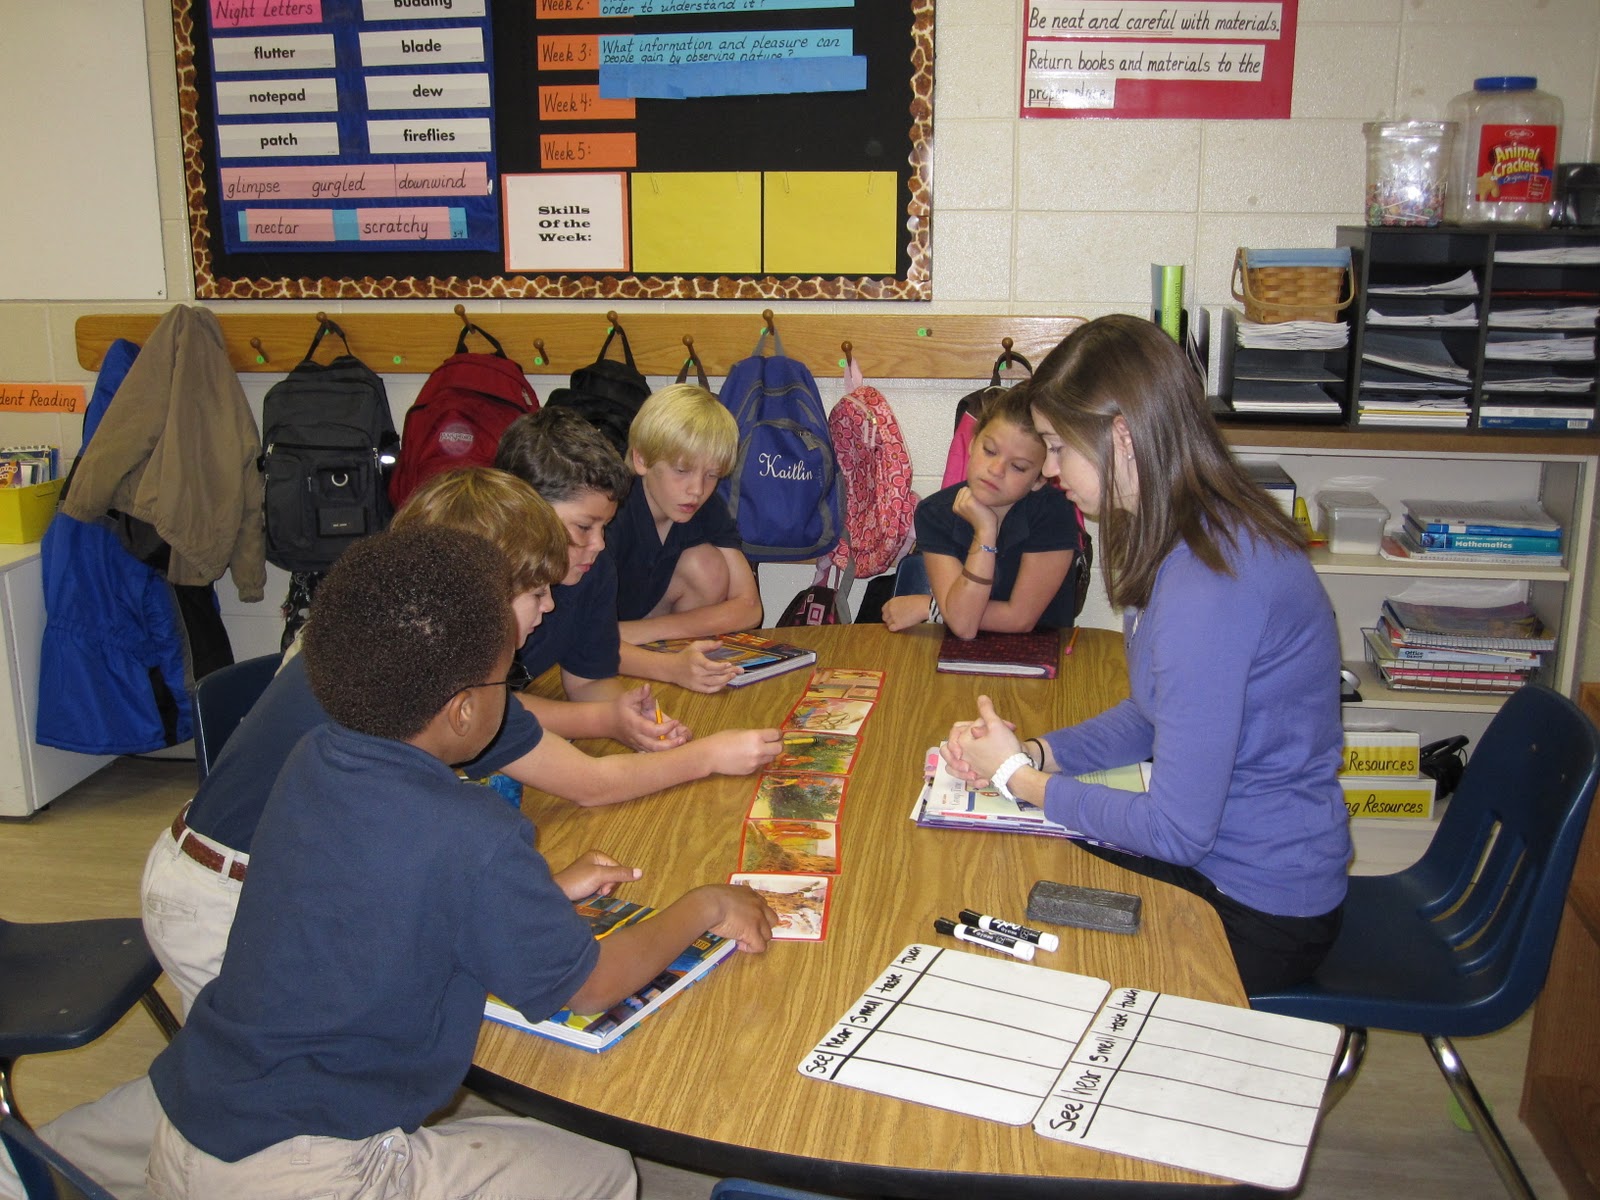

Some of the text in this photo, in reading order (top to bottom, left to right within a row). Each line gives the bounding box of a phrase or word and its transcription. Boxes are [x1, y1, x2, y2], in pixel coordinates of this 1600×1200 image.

[216, 0, 313, 26] Night Letters
[602, 4, 634, 14] order
[641, 4, 652, 13] to
[661, 0, 735, 12] understand
[1028, 7, 1281, 32] Be neat and careful with materials.
[253, 47, 296, 59] flutter
[401, 39, 442, 53] blade
[542, 42, 592, 62] Week 3:
[603, 35, 840, 54] What information and pleasure can
[603, 52, 635, 64] people
[640, 53, 664, 64] gain
[669, 51, 682, 64] by
[686, 50, 735, 62] observing
[1028, 48, 1262, 74] Return books and materials to the
[249, 89, 306, 105] notepad
[412, 84, 444, 98] dew
[544, 92, 592, 112] Week 4:
[260, 133, 298, 149] patch
[402, 129, 456, 143] fireflies
[544, 141, 591, 160] Week 5:
[1494, 142, 1541, 163] Animal
[1493, 158, 1540, 177] Crackers
[226, 168, 467, 198] glimpse gurgled downwind
[538, 206, 590, 215] Skills
[255, 213, 429, 240] nectar scratchy
[538, 219, 591, 228] Of the
[538, 233, 592, 241] Week:
[29, 389, 77, 413] Reading
[758, 452, 813, 480] Kaitlin
[1455, 540, 1513, 549] Mathematics
[1348, 751, 1415, 771] Resources
[1362, 793, 1424, 814] Resources
[897, 946, 922, 964] touch
[875, 973, 903, 993] taste
[1115, 989, 1141, 1008] touch
[1105, 1013, 1128, 1032] taste
[819, 1027, 853, 1048] hear
[806, 1054, 834, 1073] See
[1060, 1070, 1102, 1096] hear
[1049, 1103, 1084, 1131] See
